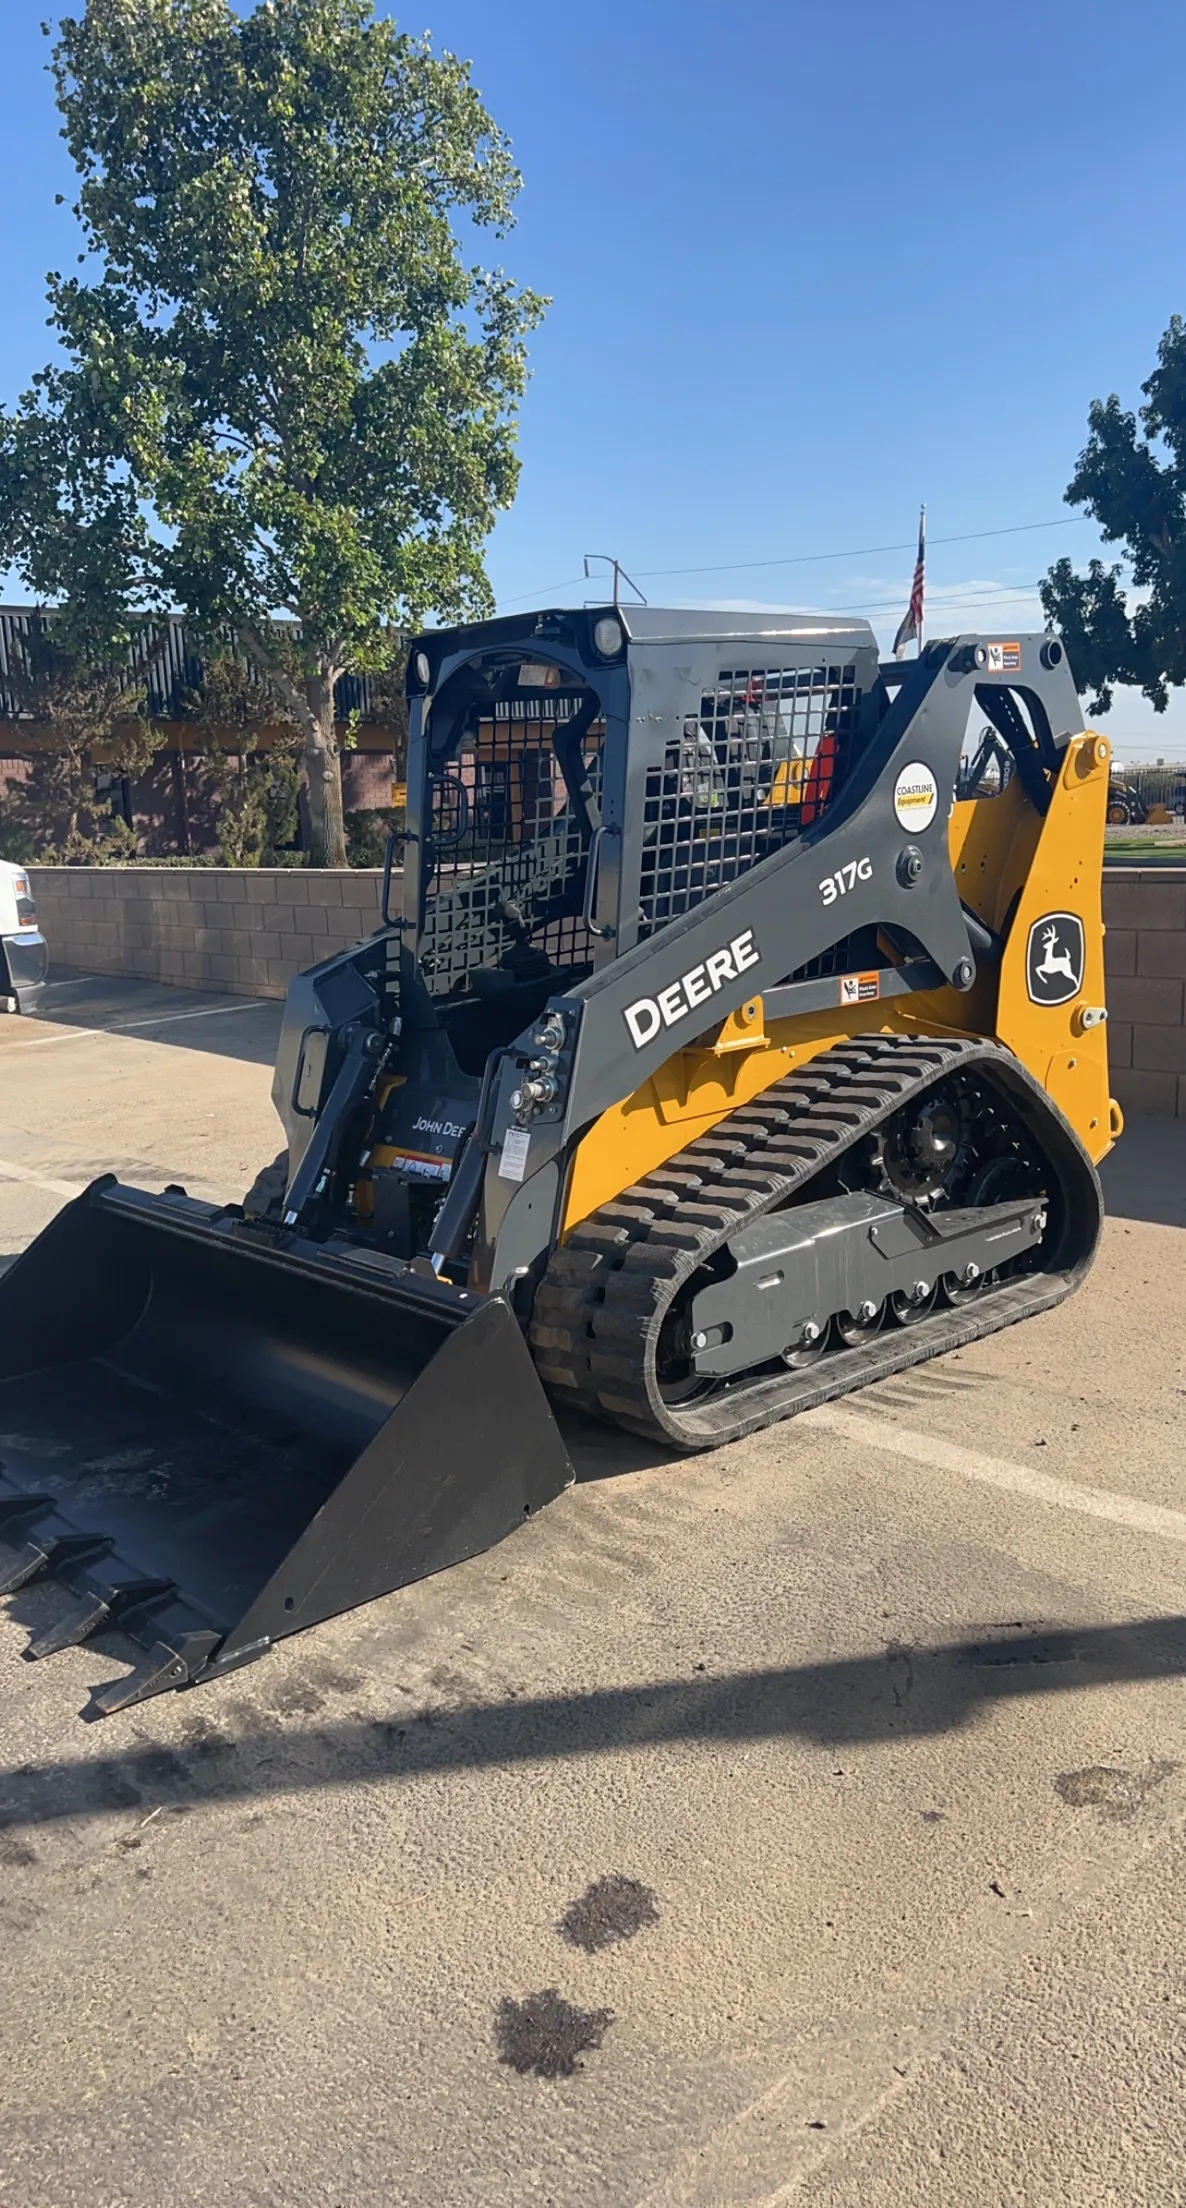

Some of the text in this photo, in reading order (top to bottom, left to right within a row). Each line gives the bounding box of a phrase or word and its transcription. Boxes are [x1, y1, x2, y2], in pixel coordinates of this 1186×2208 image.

[896, 784, 933, 796] COASTLINE
[897, 796, 927, 807] Equipment
[818, 856, 873, 906] 317G
[623, 929, 760, 1049] DEERE
[412, 1116, 467, 1138] JOHN DEE
